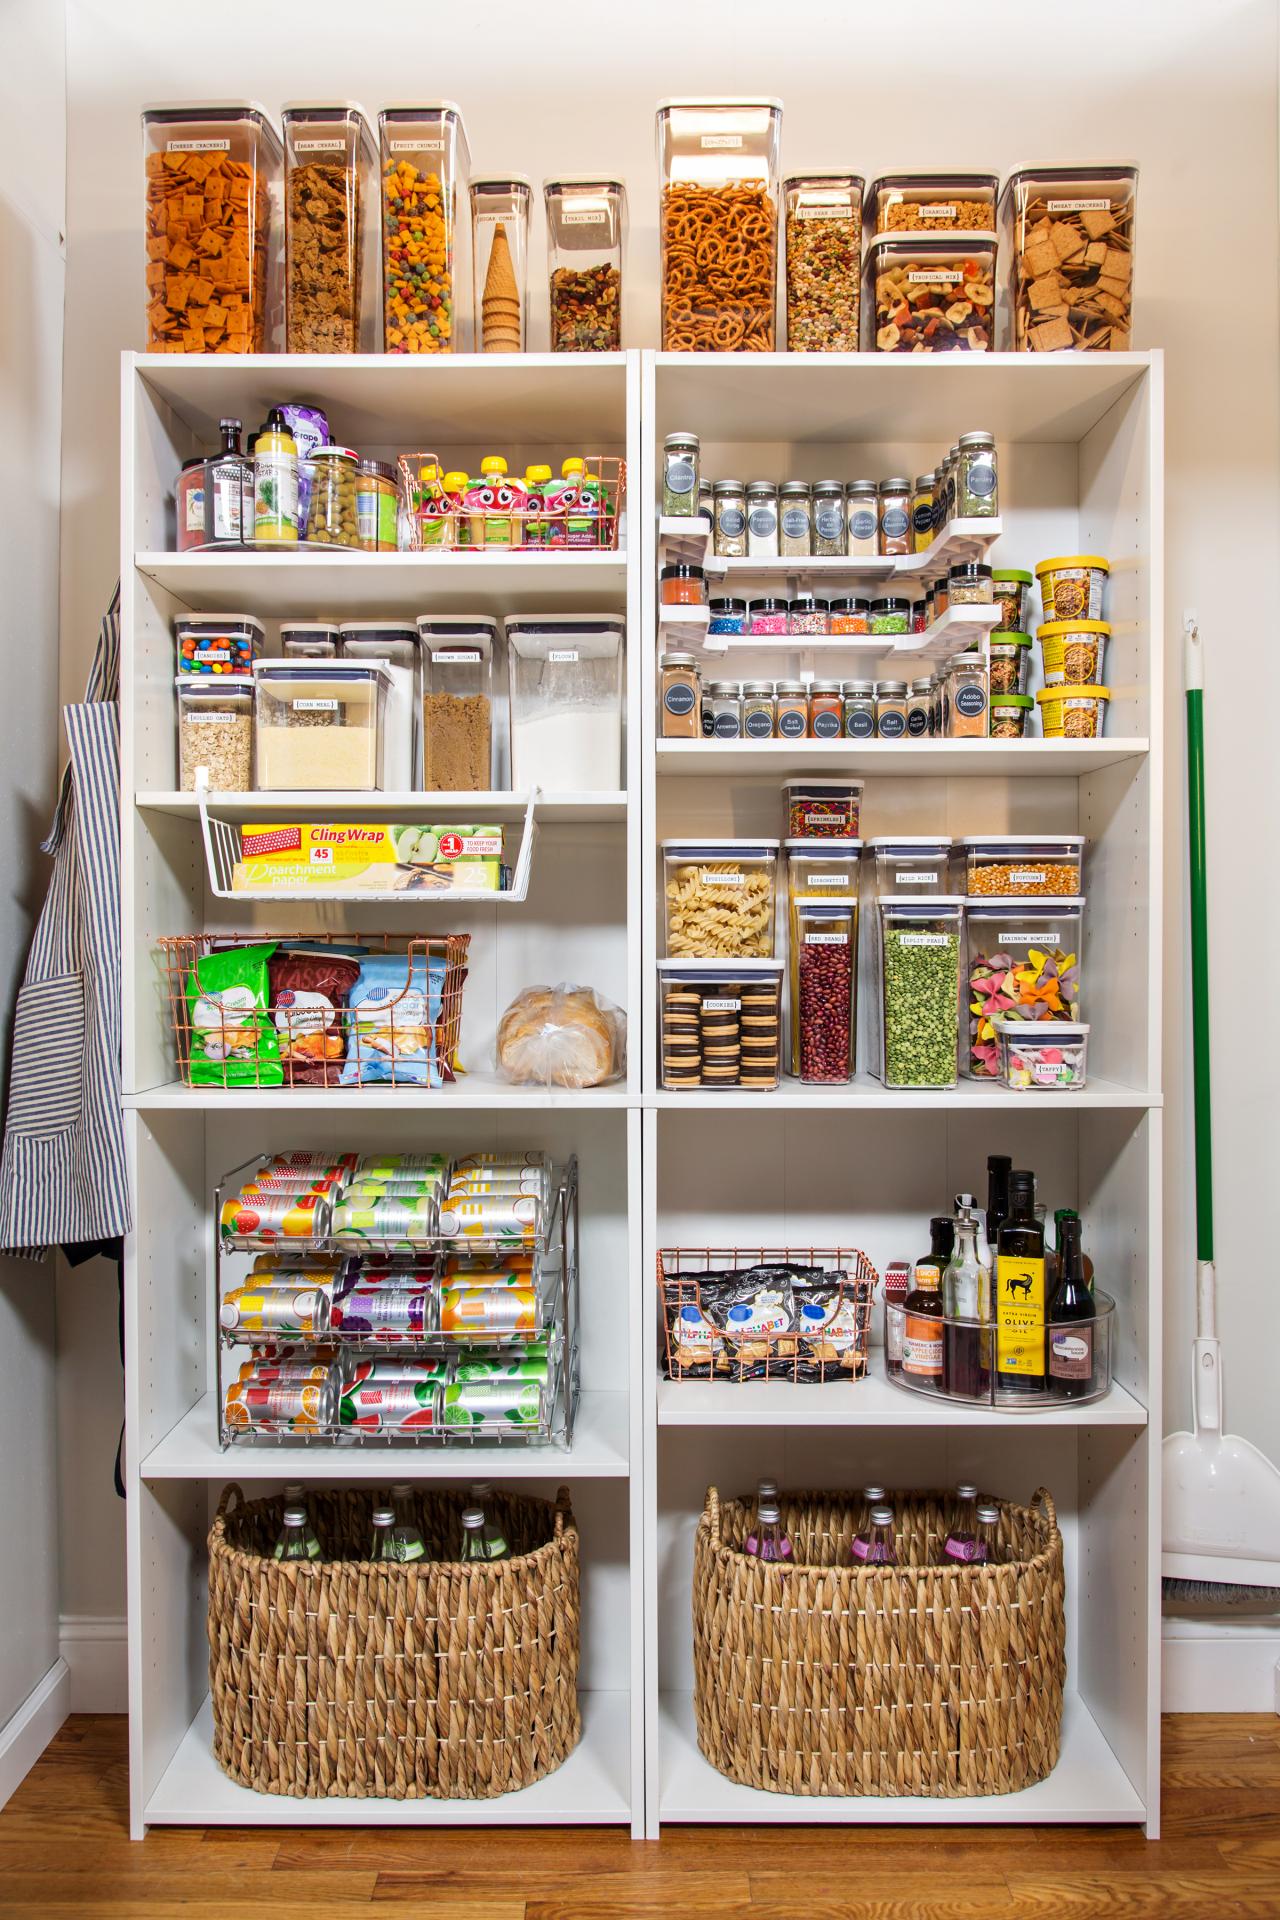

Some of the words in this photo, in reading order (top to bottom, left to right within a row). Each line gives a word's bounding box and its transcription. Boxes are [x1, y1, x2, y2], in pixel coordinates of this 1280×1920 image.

[960, 700, 983, 708] Seasoning
[816, 721, 838, 729] Paprika
[314, 848, 329, 859] 45
[269, 864, 337, 878] parchment
[463, 866, 488, 884] 25
[272, 875, 310, 888] paper
[706, 1000, 737, 1009] {COOKIES}
[1038, 1065, 1063, 1073] {TAFFY}
